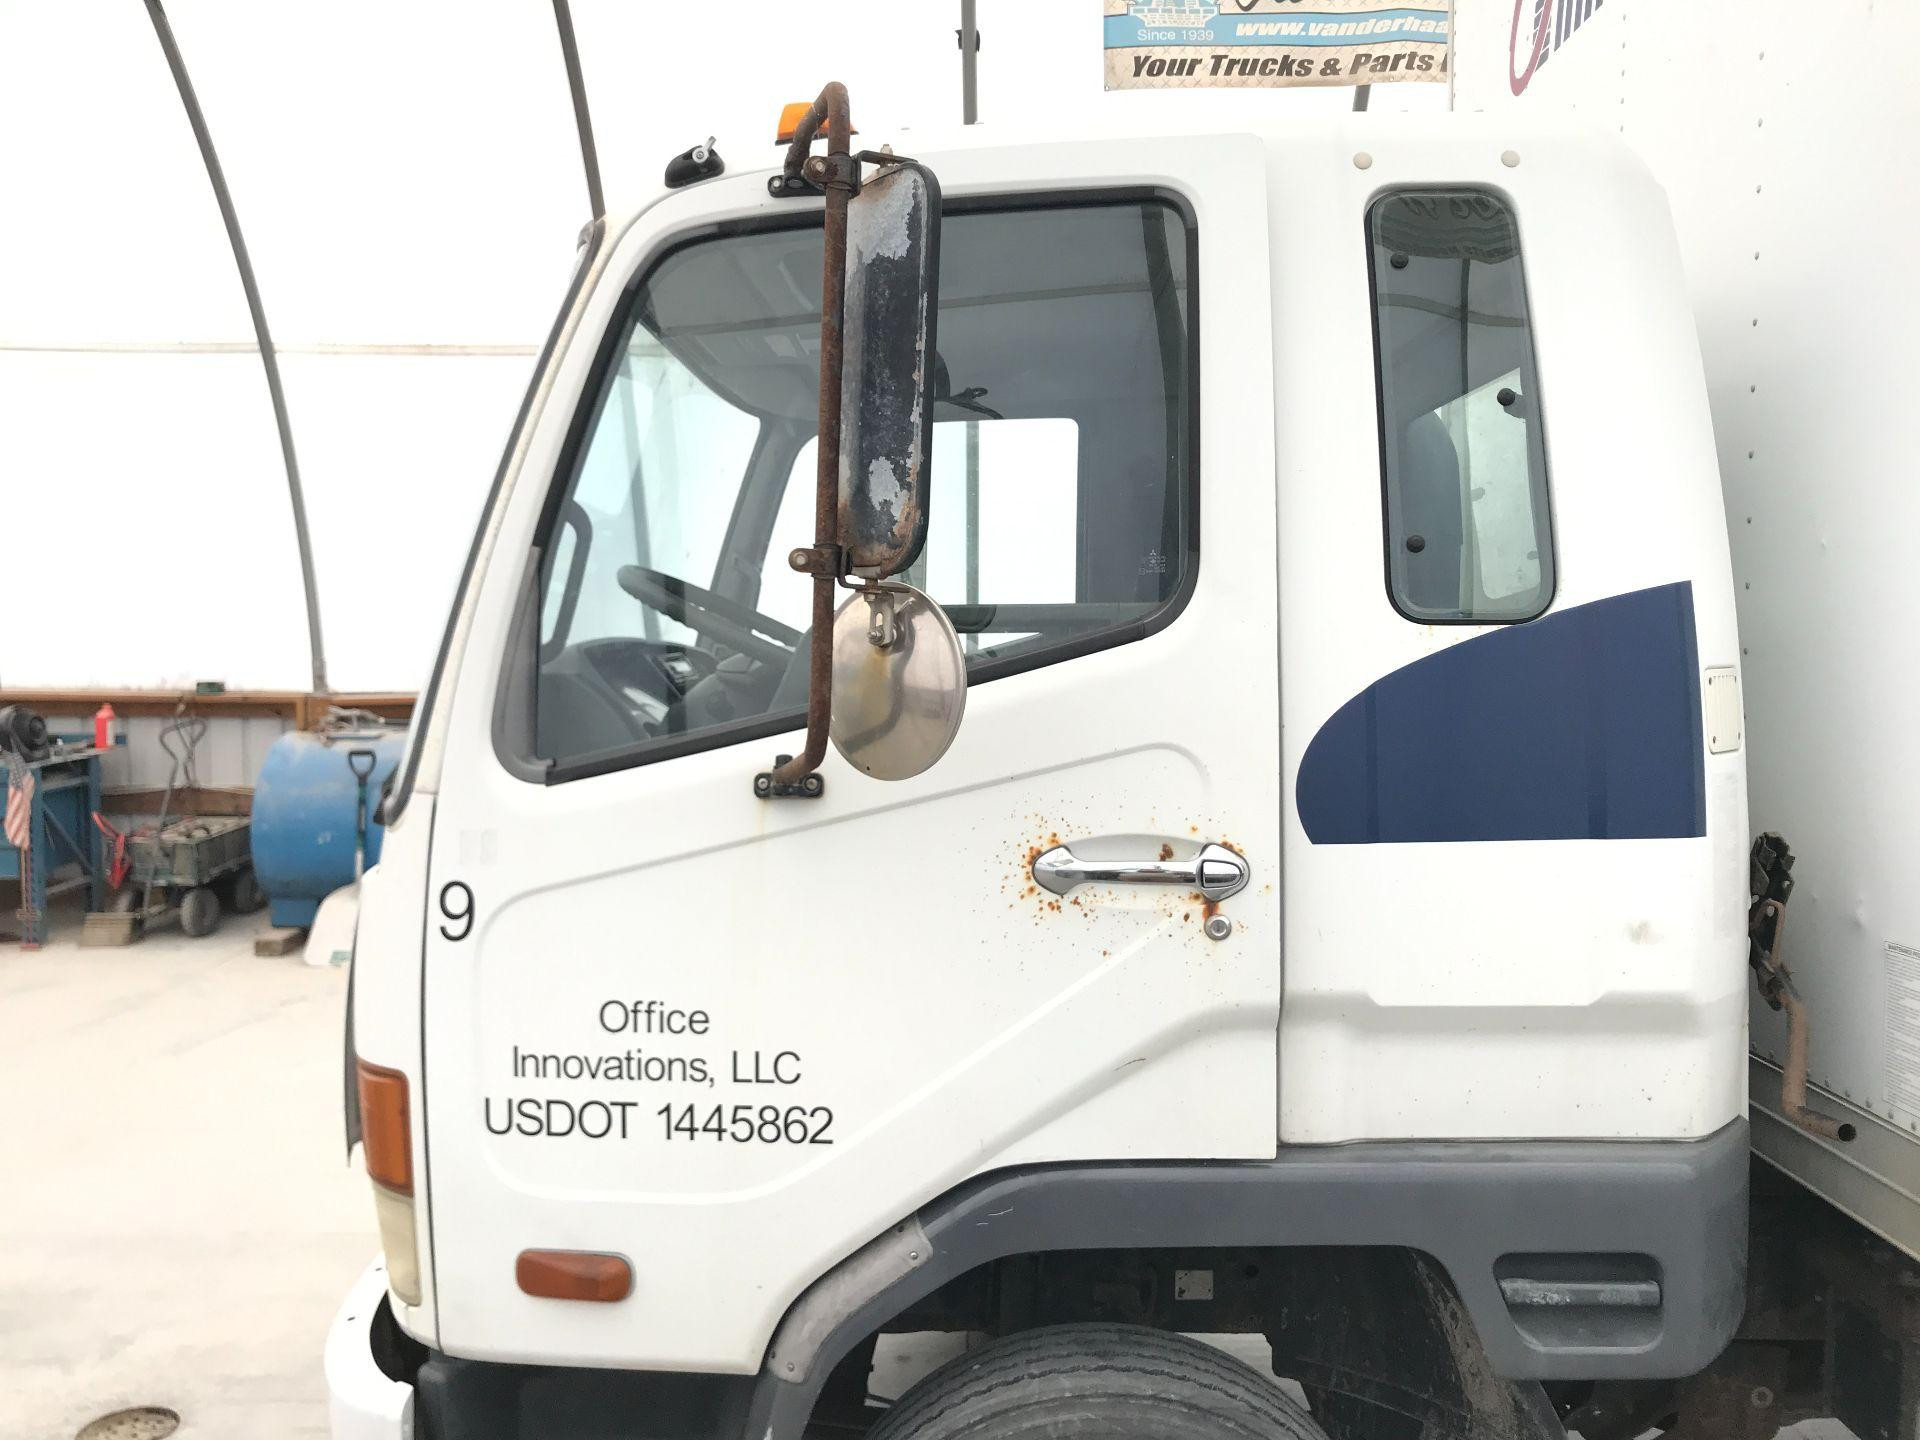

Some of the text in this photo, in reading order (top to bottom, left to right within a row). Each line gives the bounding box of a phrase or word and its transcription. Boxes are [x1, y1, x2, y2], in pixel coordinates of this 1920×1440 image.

[1136, 29, 1214, 41] Since 1939
[1132, 55, 1202, 77] Your
[1210, 54, 1314, 77] Trucks
[1319, 58, 1342, 76] &
[1350, 51, 1433, 75] Parts
[440, 881, 475, 942] 9
[599, 1000, 711, 1035] Office
[513, 1046, 802, 1088] Innovations, LLC
[484, 1098, 834, 1145] USDOT 1445862
